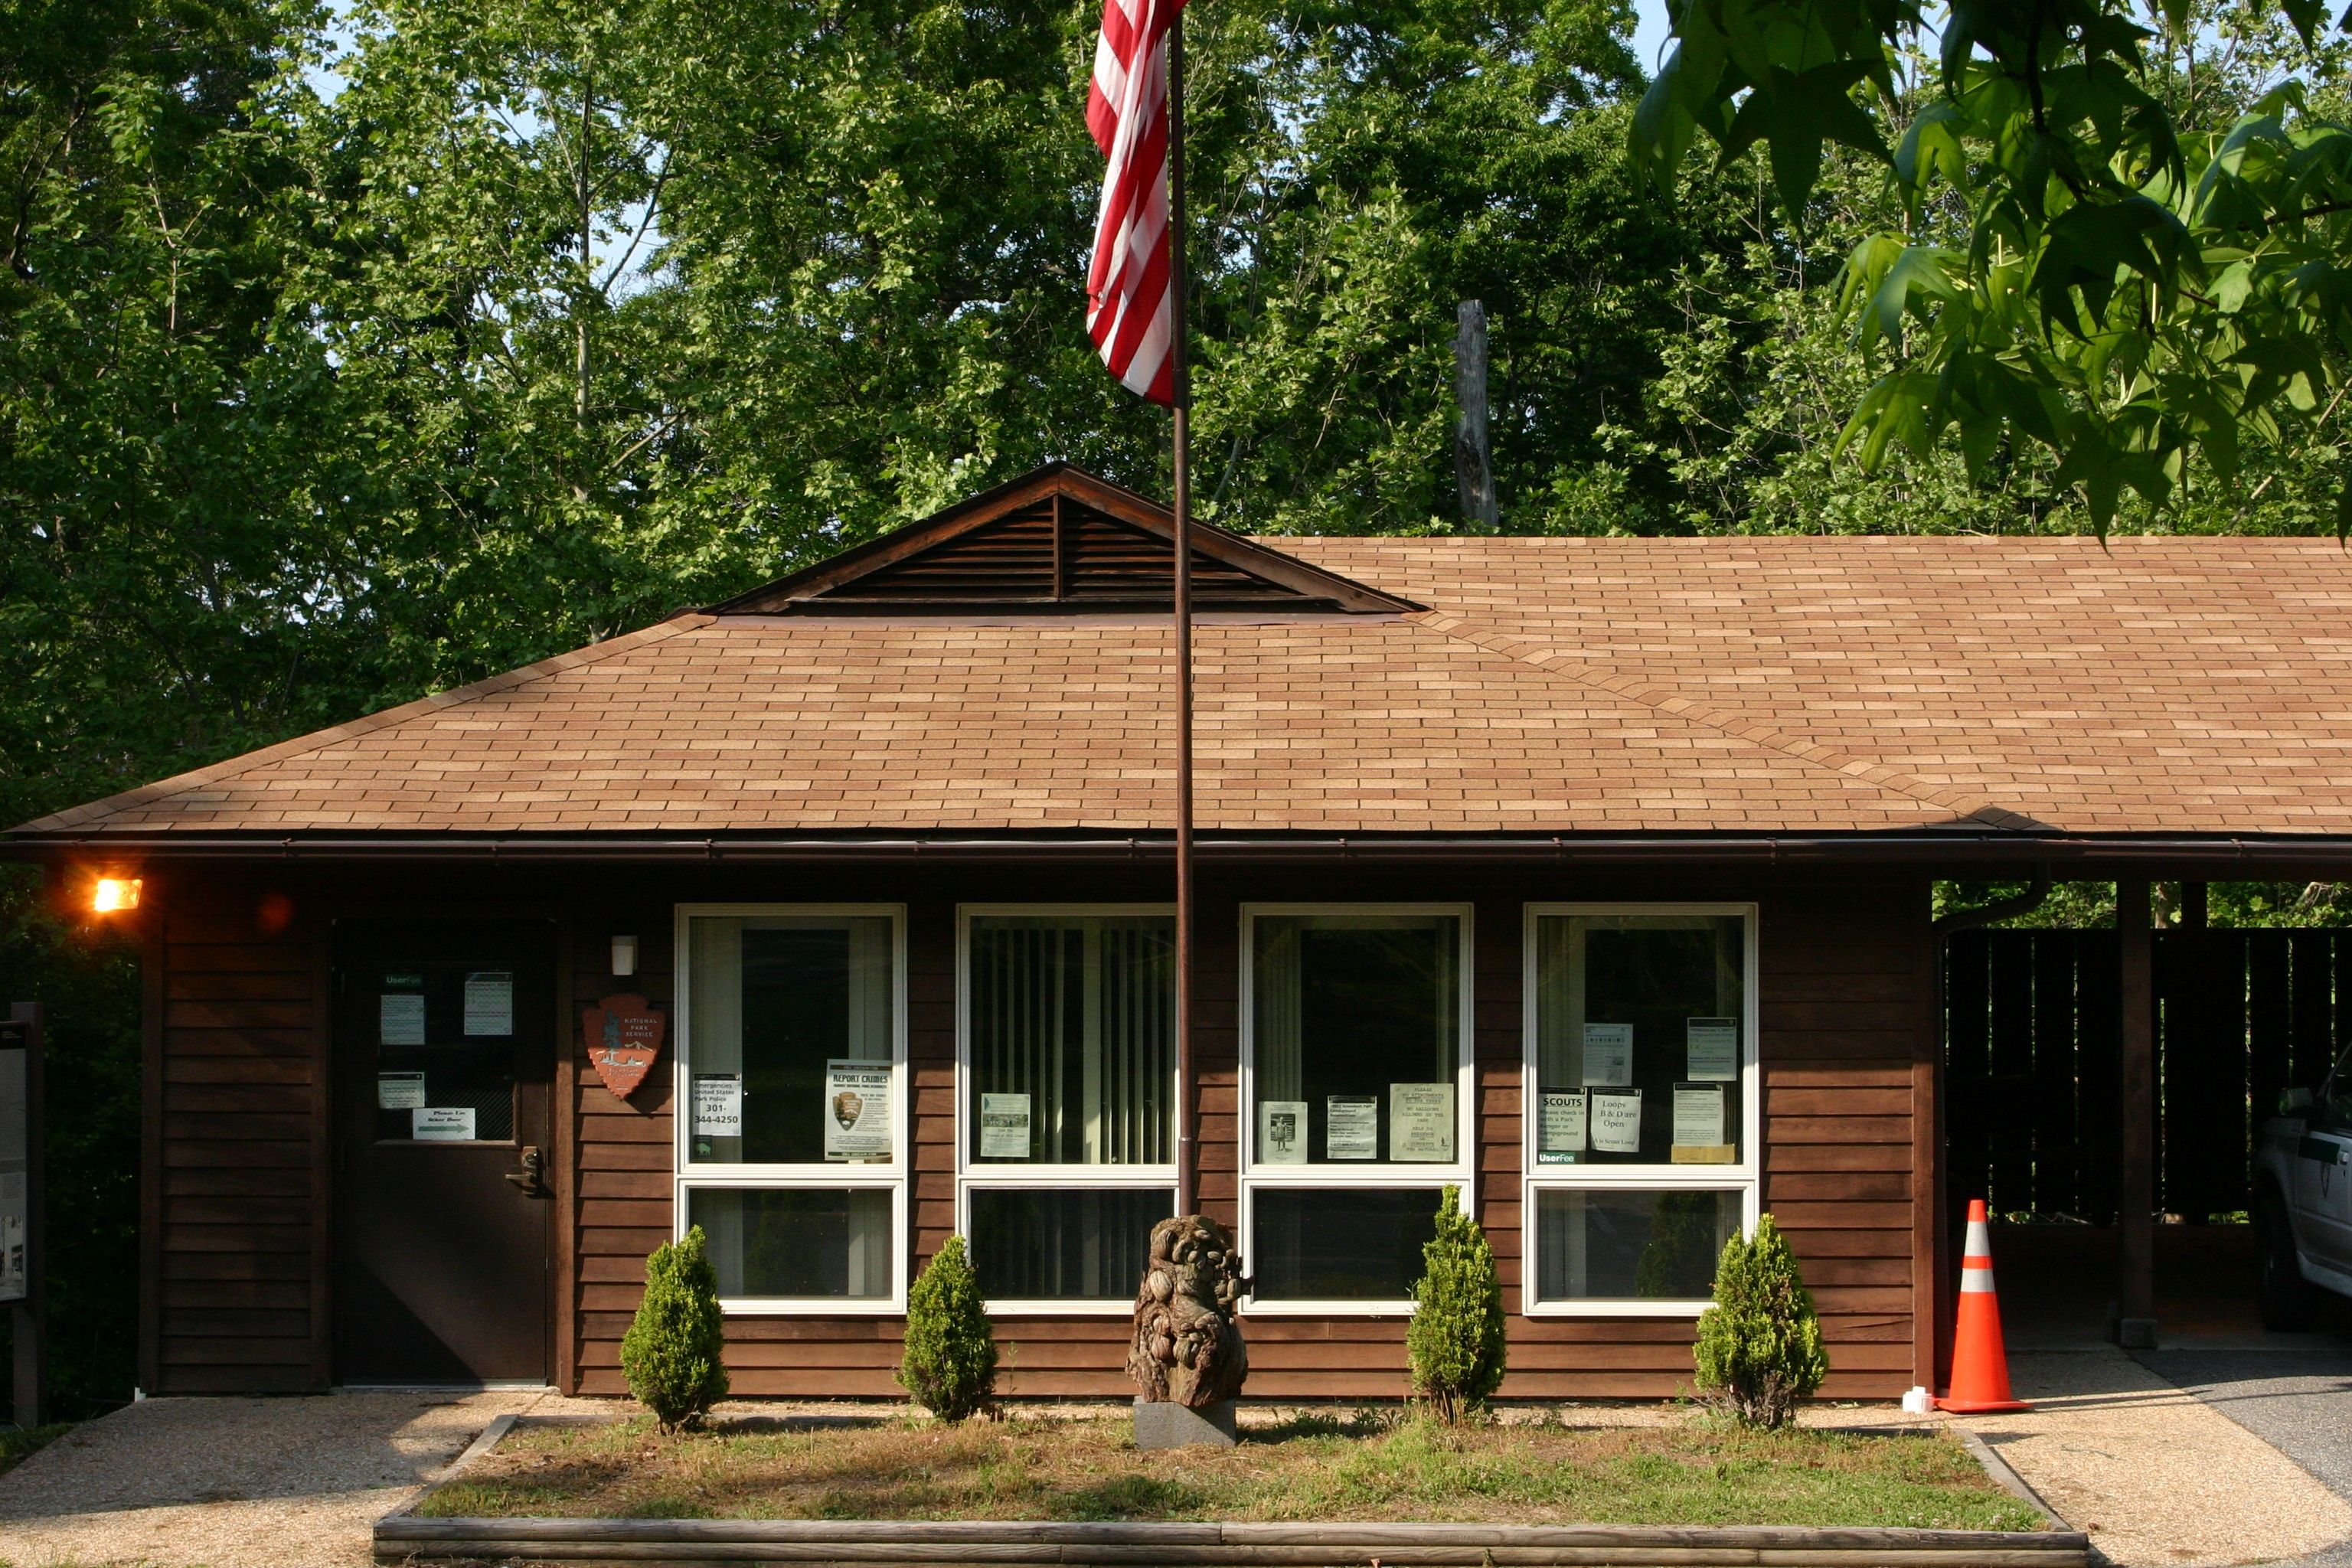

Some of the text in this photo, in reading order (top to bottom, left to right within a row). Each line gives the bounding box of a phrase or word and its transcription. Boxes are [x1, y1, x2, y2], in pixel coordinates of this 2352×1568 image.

[833, 1074, 888, 1083] REPORT CRIMES
[1544, 1098, 1583, 1106] SCOUTS
[1602, 1100, 1626, 1109] Loops
[1603, 1119, 1625, 1129] Open
[1539, 1154, 1574, 1162] UserFee
